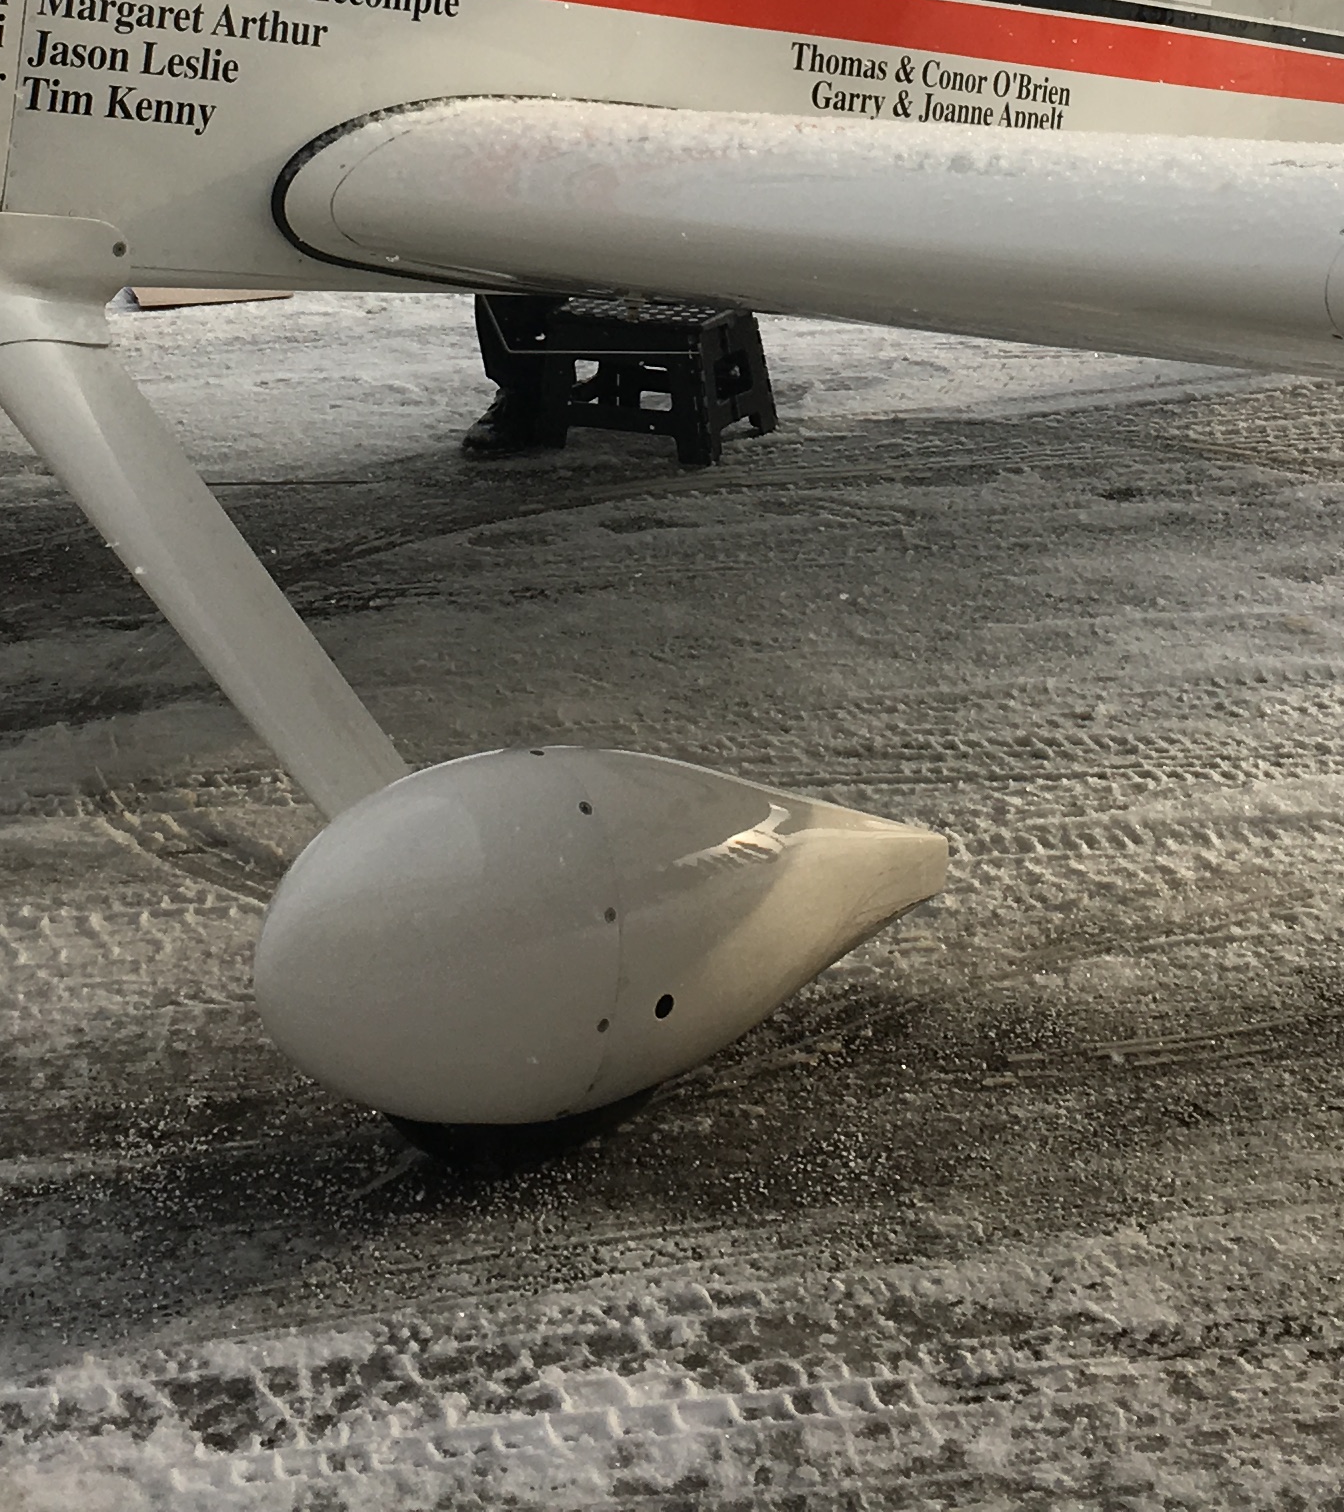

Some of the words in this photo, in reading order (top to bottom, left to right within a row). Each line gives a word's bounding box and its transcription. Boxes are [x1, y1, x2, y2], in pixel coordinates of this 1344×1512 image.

[212, 3, 329, 48] Arthur
[27, 29, 129, 71] Jason
[140, 41, 240, 83] Leslie
[791, 41, 889, 82] Thomas
[895, 55, 915, 85] &
[921, 59, 988, 99] Conor
[992, 69, 1072, 107] O'Brien
[23, 76, 93, 117] Tim
[104, 85, 217, 136] Kenny
[810, 81, 885, 120] Garry
[893, 90, 913, 119] &
[918, 94, 1006, 127] Joanne
